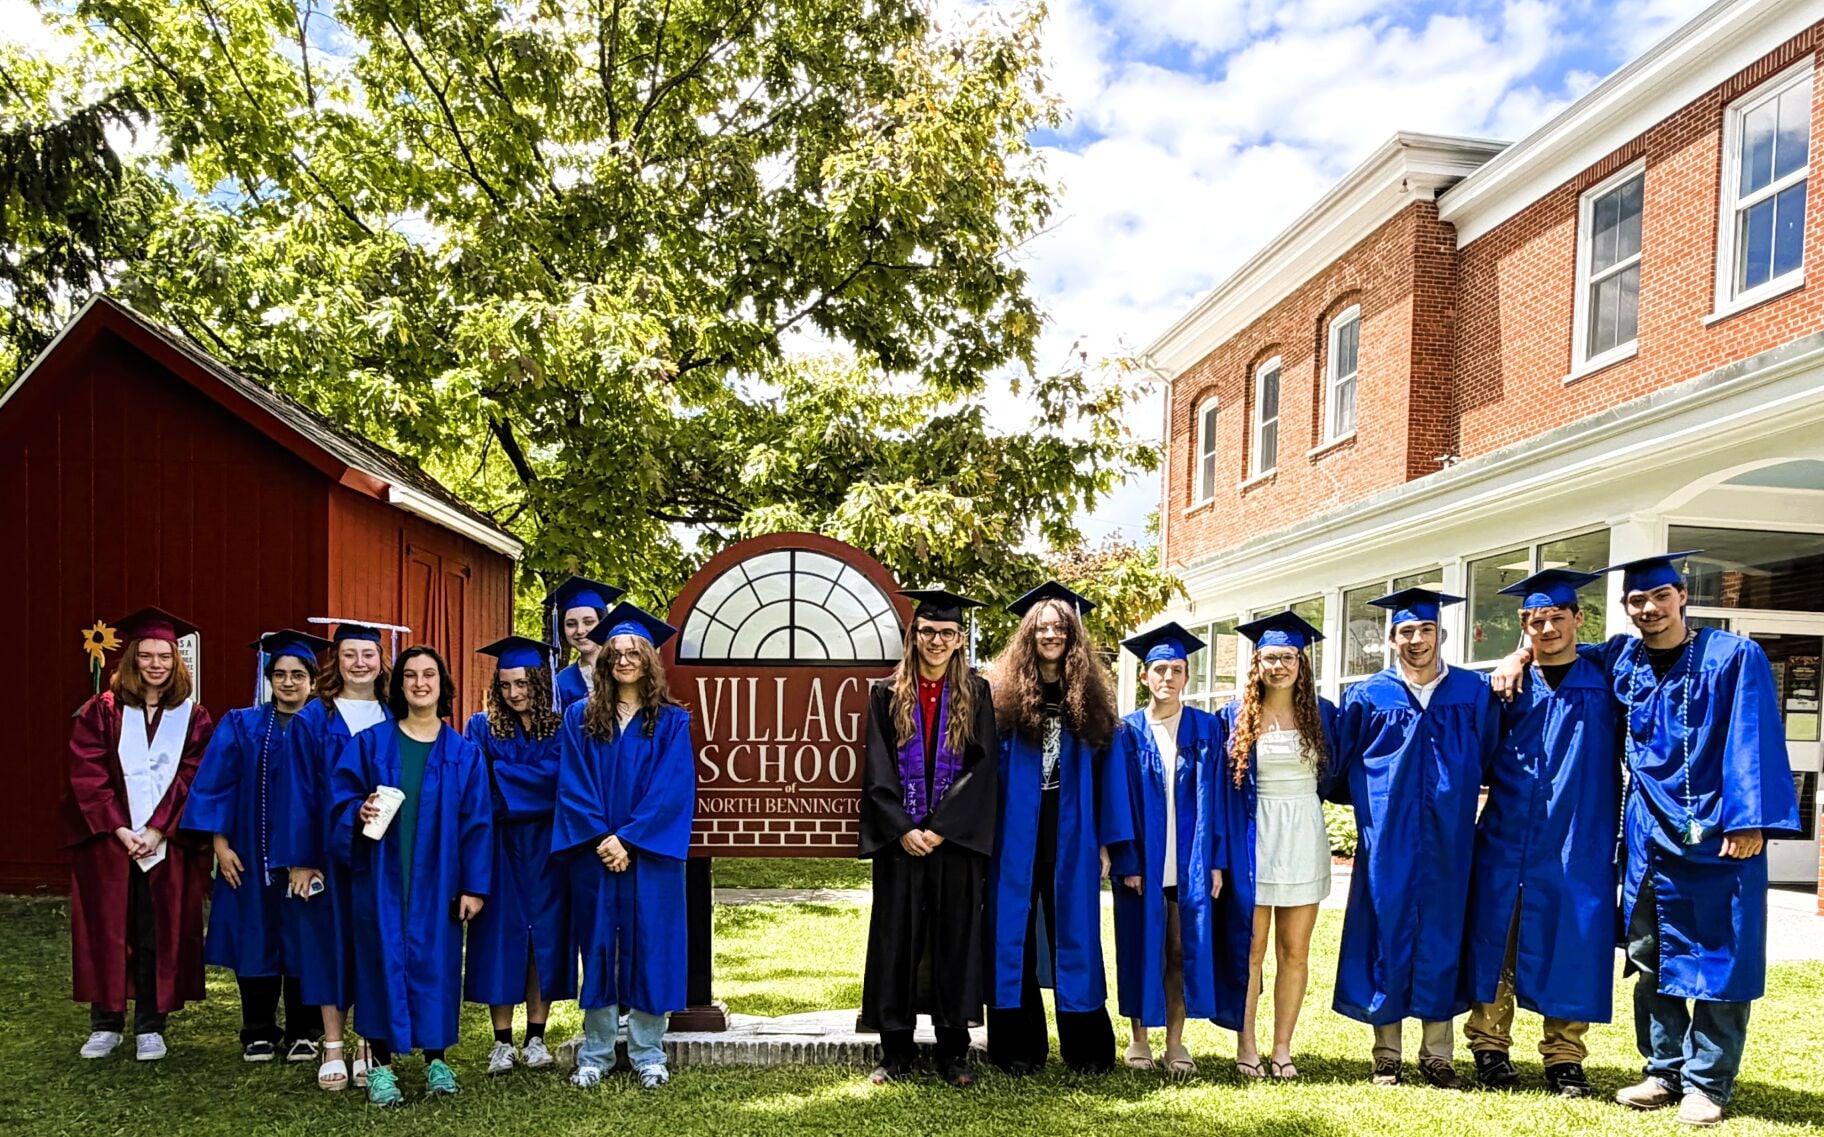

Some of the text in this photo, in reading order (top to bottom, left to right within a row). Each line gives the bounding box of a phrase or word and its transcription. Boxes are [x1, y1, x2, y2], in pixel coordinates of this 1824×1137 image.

[698, 744, 866, 783] SCHOO
[784, 782, 798, 794] of
[698, 797, 761, 813] NORTH
